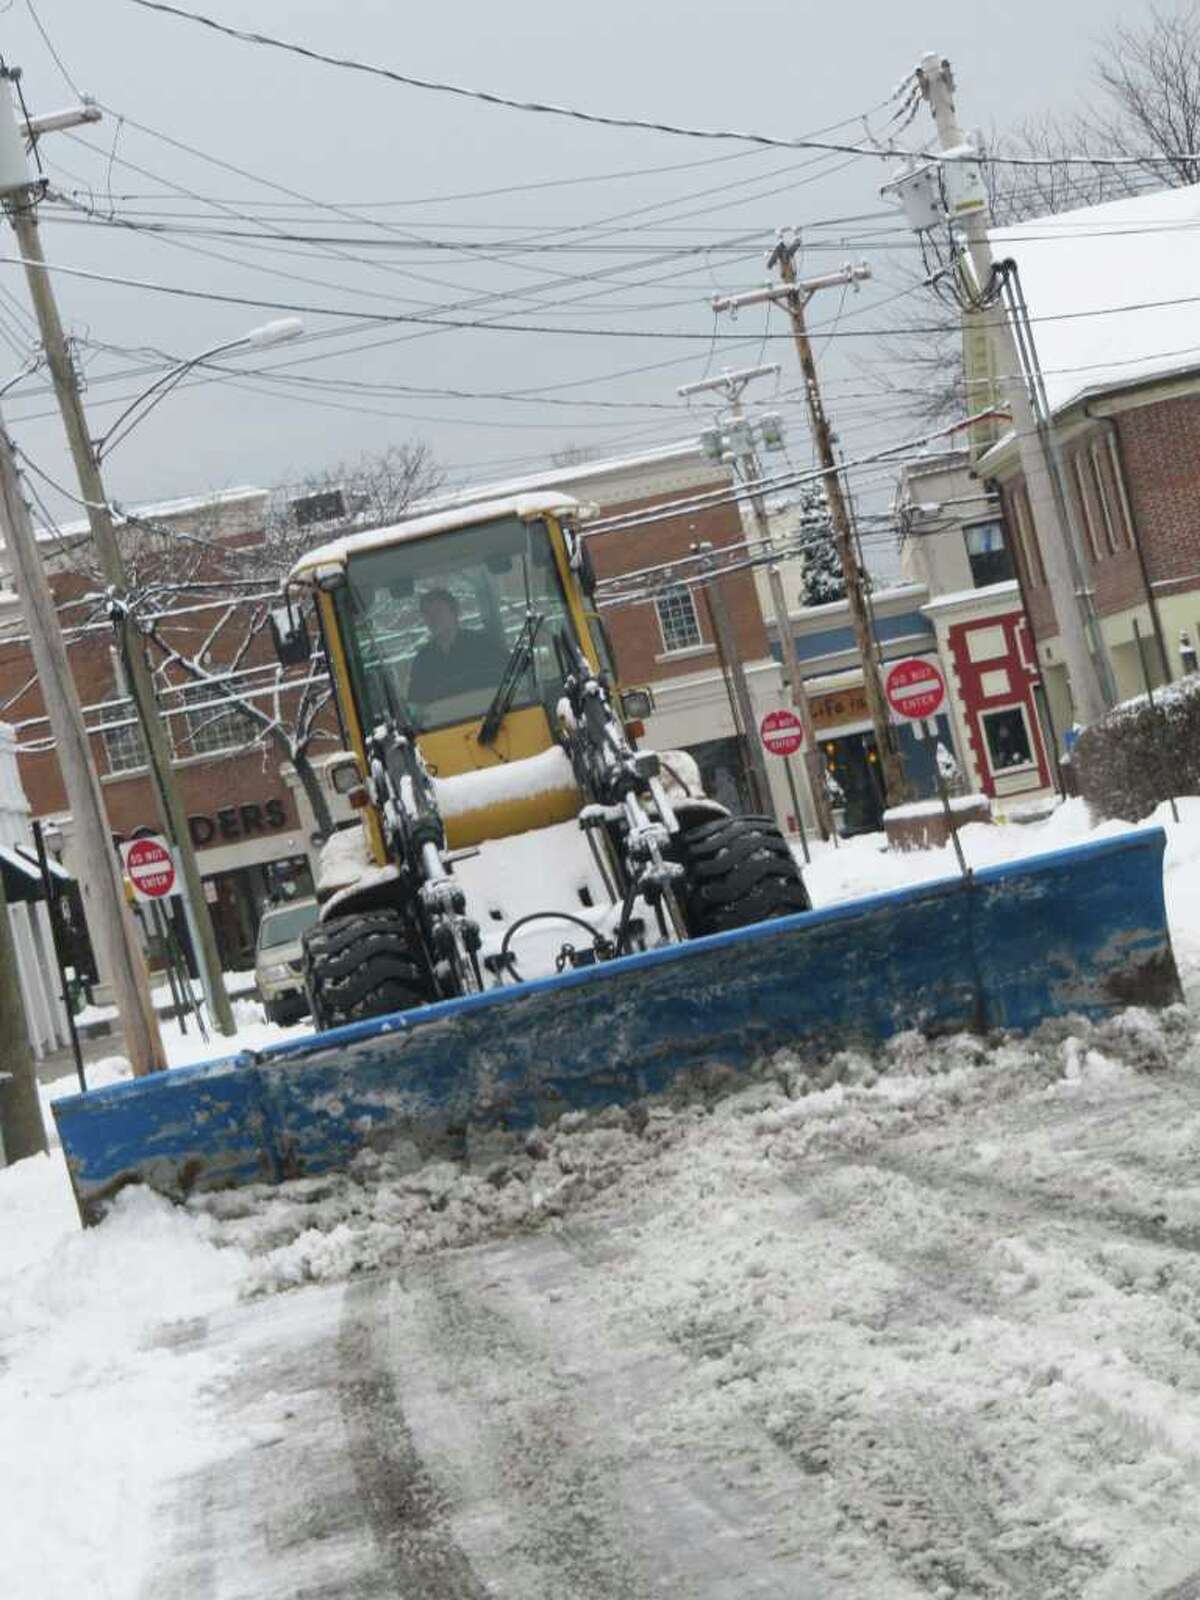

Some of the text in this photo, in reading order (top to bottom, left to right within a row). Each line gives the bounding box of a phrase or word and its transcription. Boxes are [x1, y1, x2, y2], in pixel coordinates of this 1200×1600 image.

[890, 667, 932, 687] DO NOT
[902, 695, 935, 711] ENTER
[187, 799, 286, 847] DERS
[144, 848, 164, 862] NOT
[140, 875, 168, 889] ENTER
